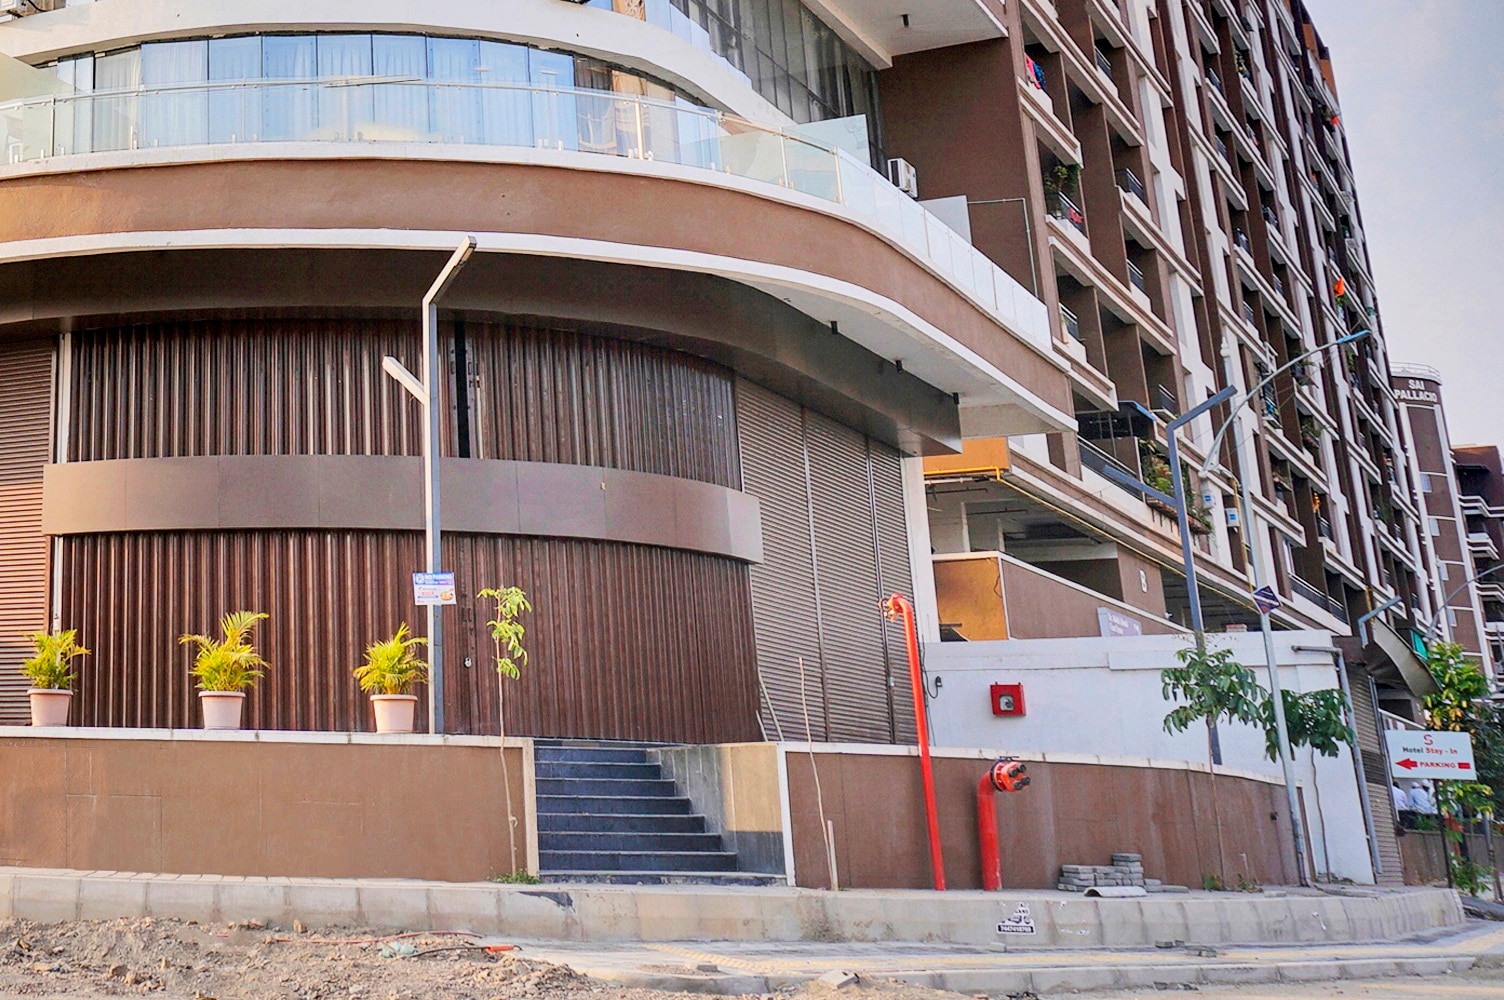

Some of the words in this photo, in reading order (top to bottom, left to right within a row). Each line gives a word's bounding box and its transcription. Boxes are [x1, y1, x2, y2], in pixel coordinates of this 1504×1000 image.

[1408, 379, 1425, 390] SAI
[1394, 389, 1437, 402] PALLACIO
[1402, 746, 1424, 754] Hotel
[1419, 761, 1456, 769] PARKING
